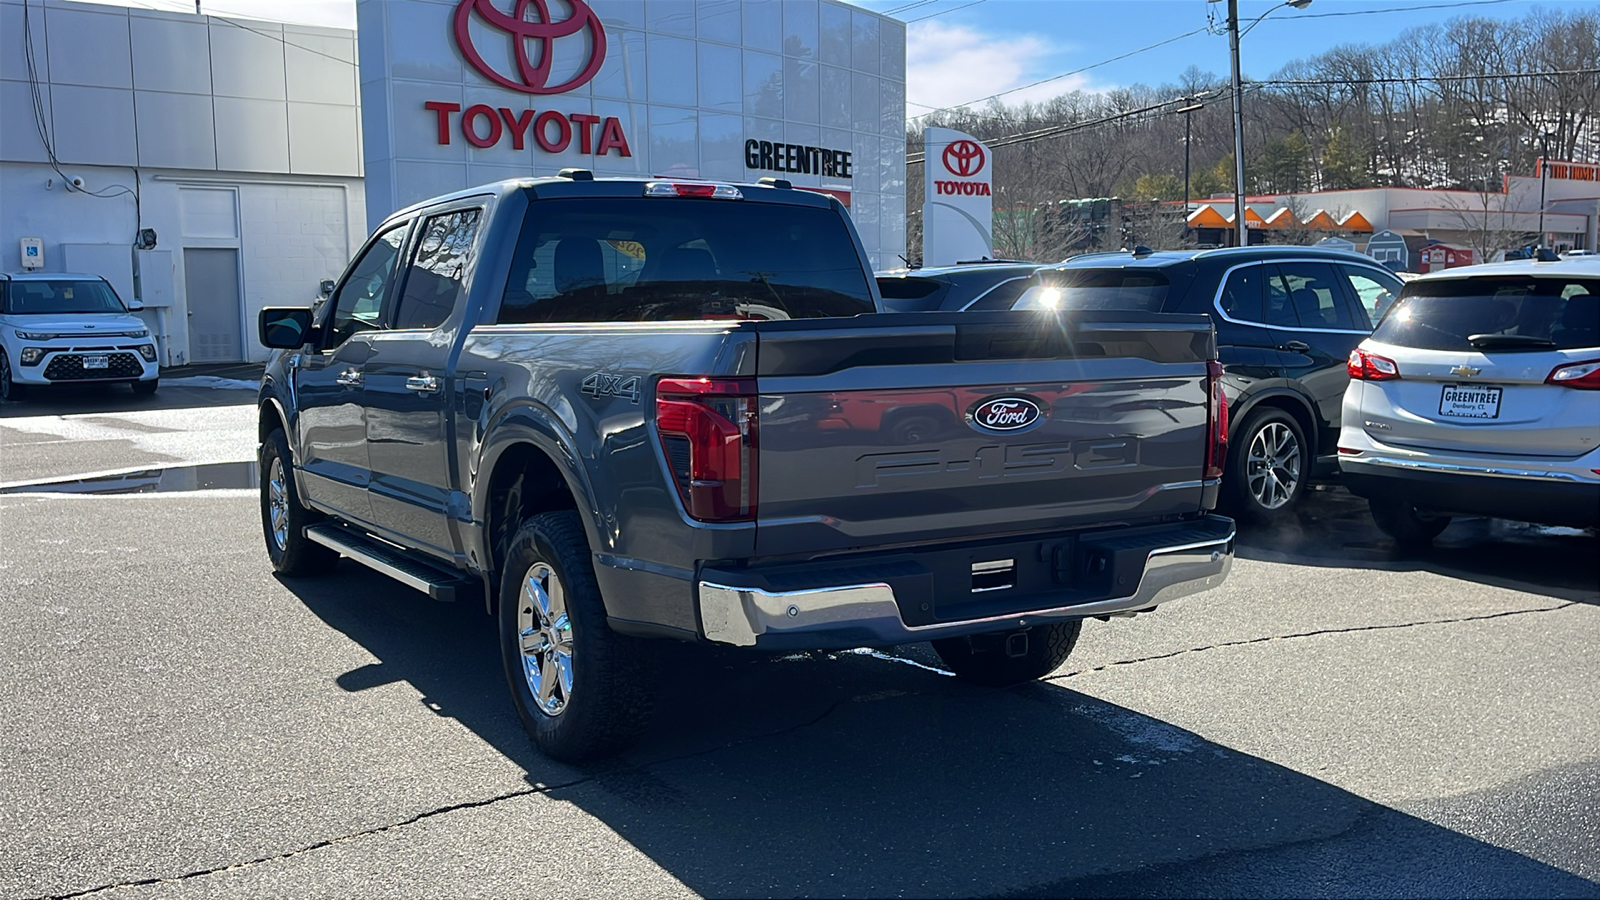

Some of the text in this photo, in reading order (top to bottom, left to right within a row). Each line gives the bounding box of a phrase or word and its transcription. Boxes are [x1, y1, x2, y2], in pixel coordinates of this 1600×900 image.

[425, 101, 631, 157] TOYOTA
[745, 139, 852, 179] GREENTREE
[1549, 163, 1567, 179] THE
[1569, 165, 1595, 182] HOME
[934, 180, 991, 196] TOYOTA
[1445, 391, 1497, 403] GREENTREE
[986, 402, 1029, 425] Ford
[854, 435, 1141, 489] F-150
